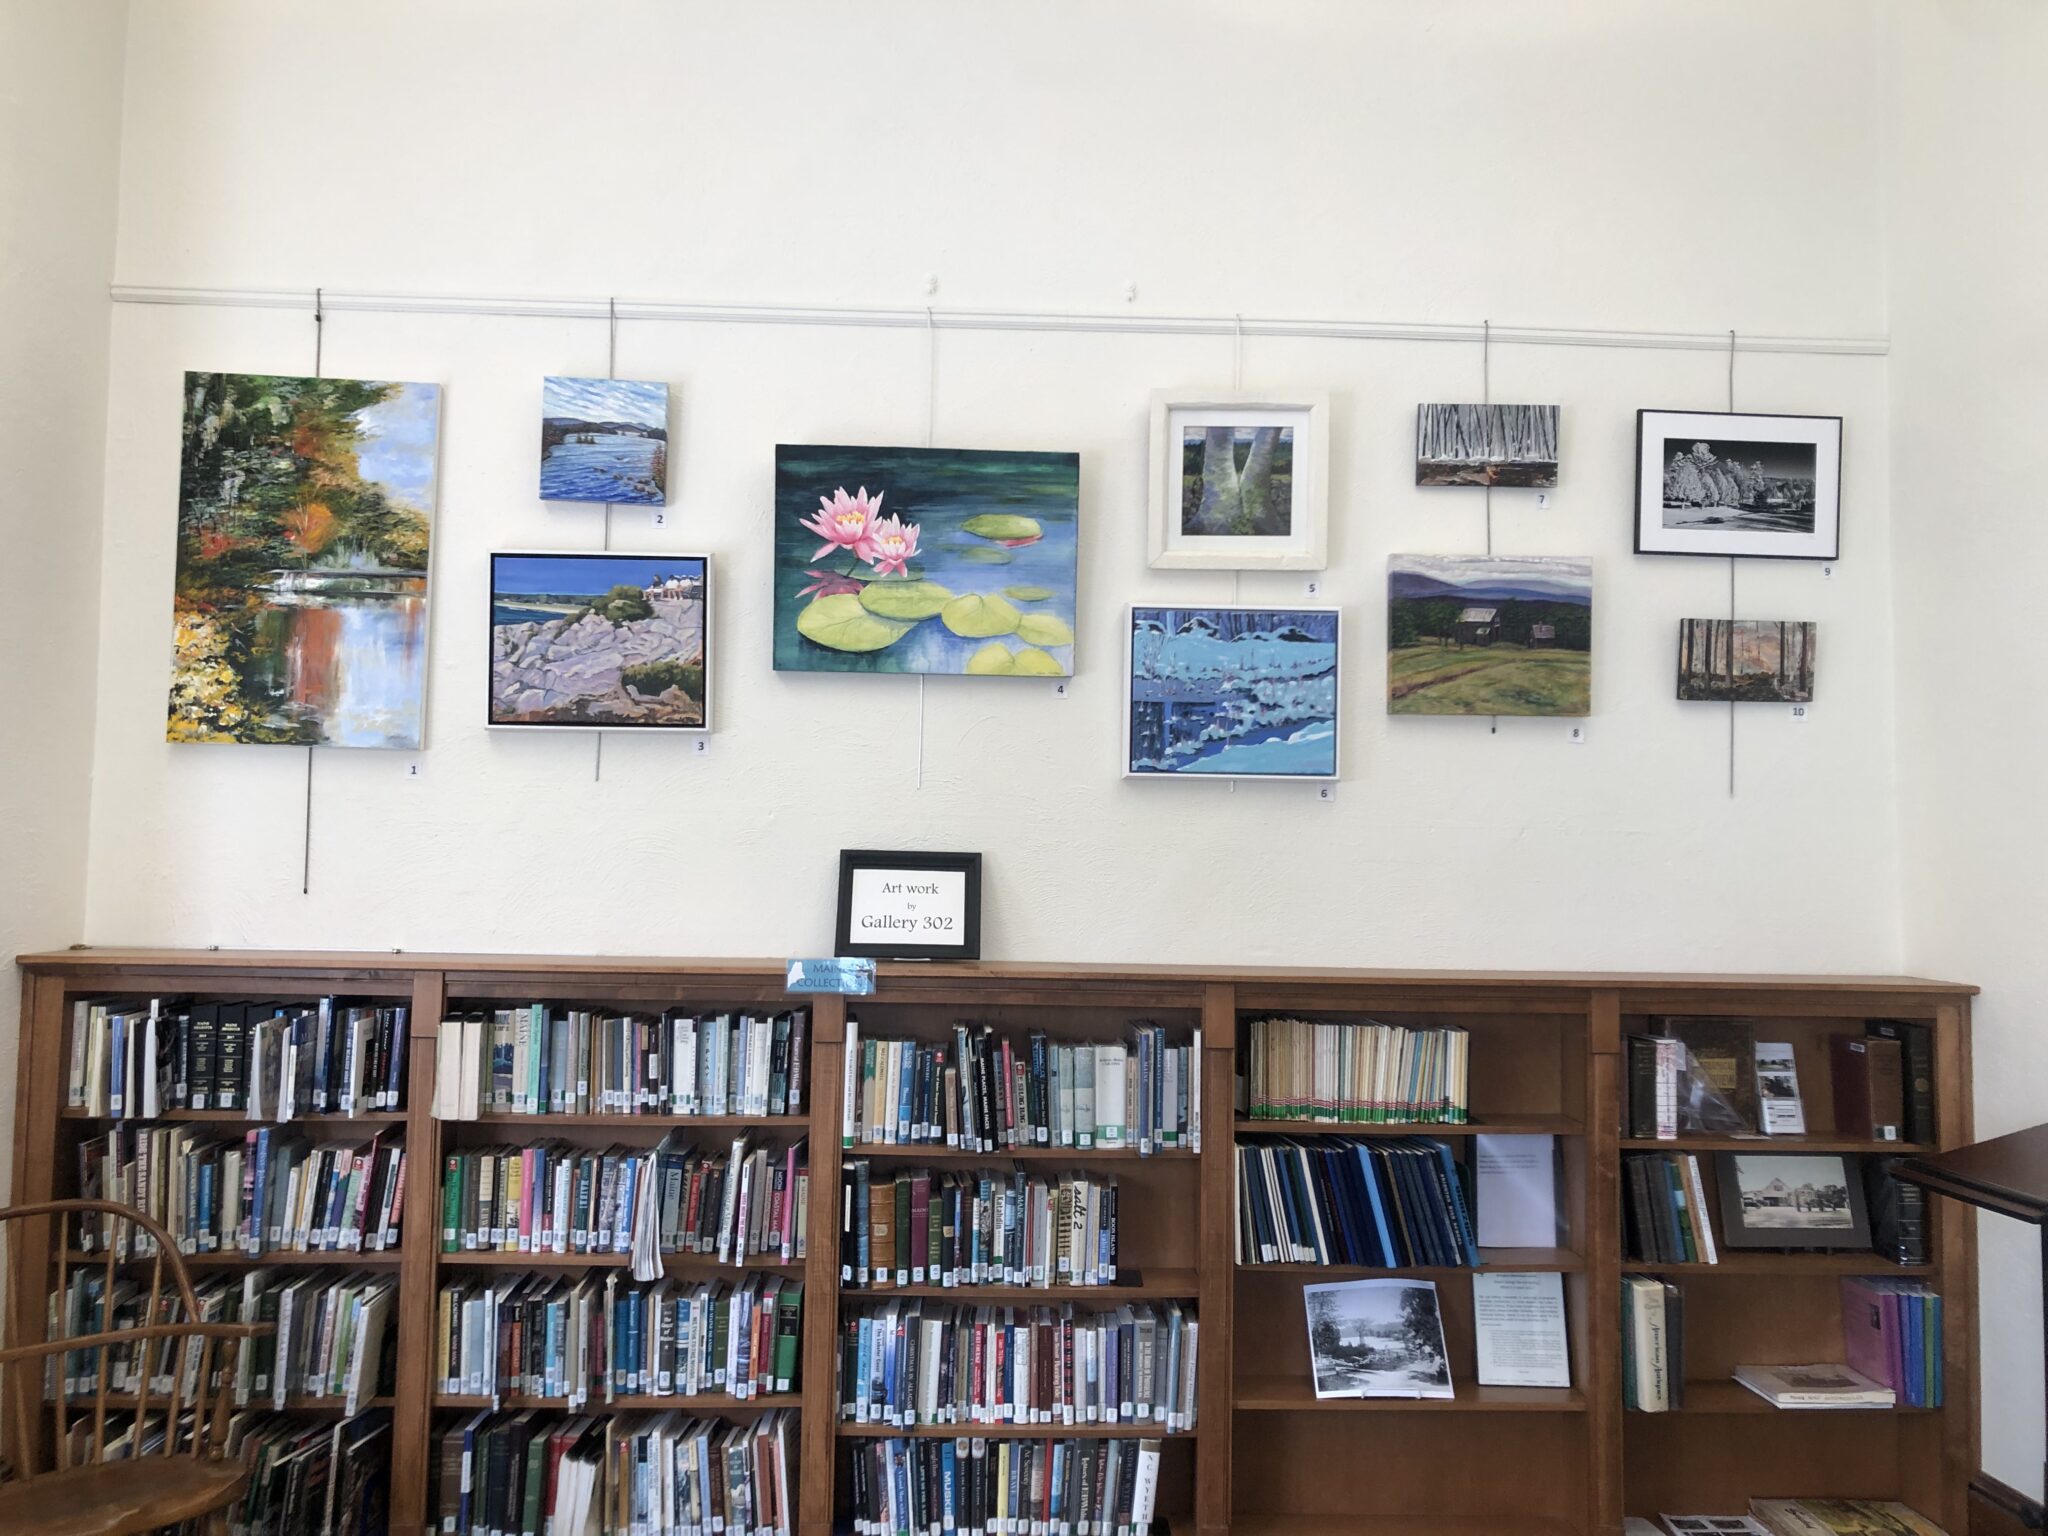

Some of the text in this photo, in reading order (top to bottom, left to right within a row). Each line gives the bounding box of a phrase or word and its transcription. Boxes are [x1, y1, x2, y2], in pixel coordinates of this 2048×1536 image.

[656, 515, 664, 524] 2
[1309, 584, 1316, 593] 5
[1057, 685, 1064, 694] 4
[1792, 707, 1805, 716] 10
[698, 742, 705, 751] 3
[410, 766, 417, 775] 1
[1320, 789, 1328, 798] 6
[882, 882, 940, 895] Art work
[907, 902, 917, 911] by
[861, 915, 953, 932] Gallery 302
[519, 1014, 529, 1045] MAINE
[138, 1133, 148, 1154] RIDE
[138, 1154, 147, 1171] THE
[137, 1171, 147, 1198] SANDY
[669, 1171, 680, 1200] Maine
[776, 1171, 784, 1190] MOON
[995, 1196, 1004, 1229] Katahdin
[1073, 1185, 1087, 1230] salt 2
[1052, 1360, 1060, 1385] Running
[1021, 1459, 1031, 1486] Seventy
[1122, 1445, 1134, 1512] ANDREW WYETH
